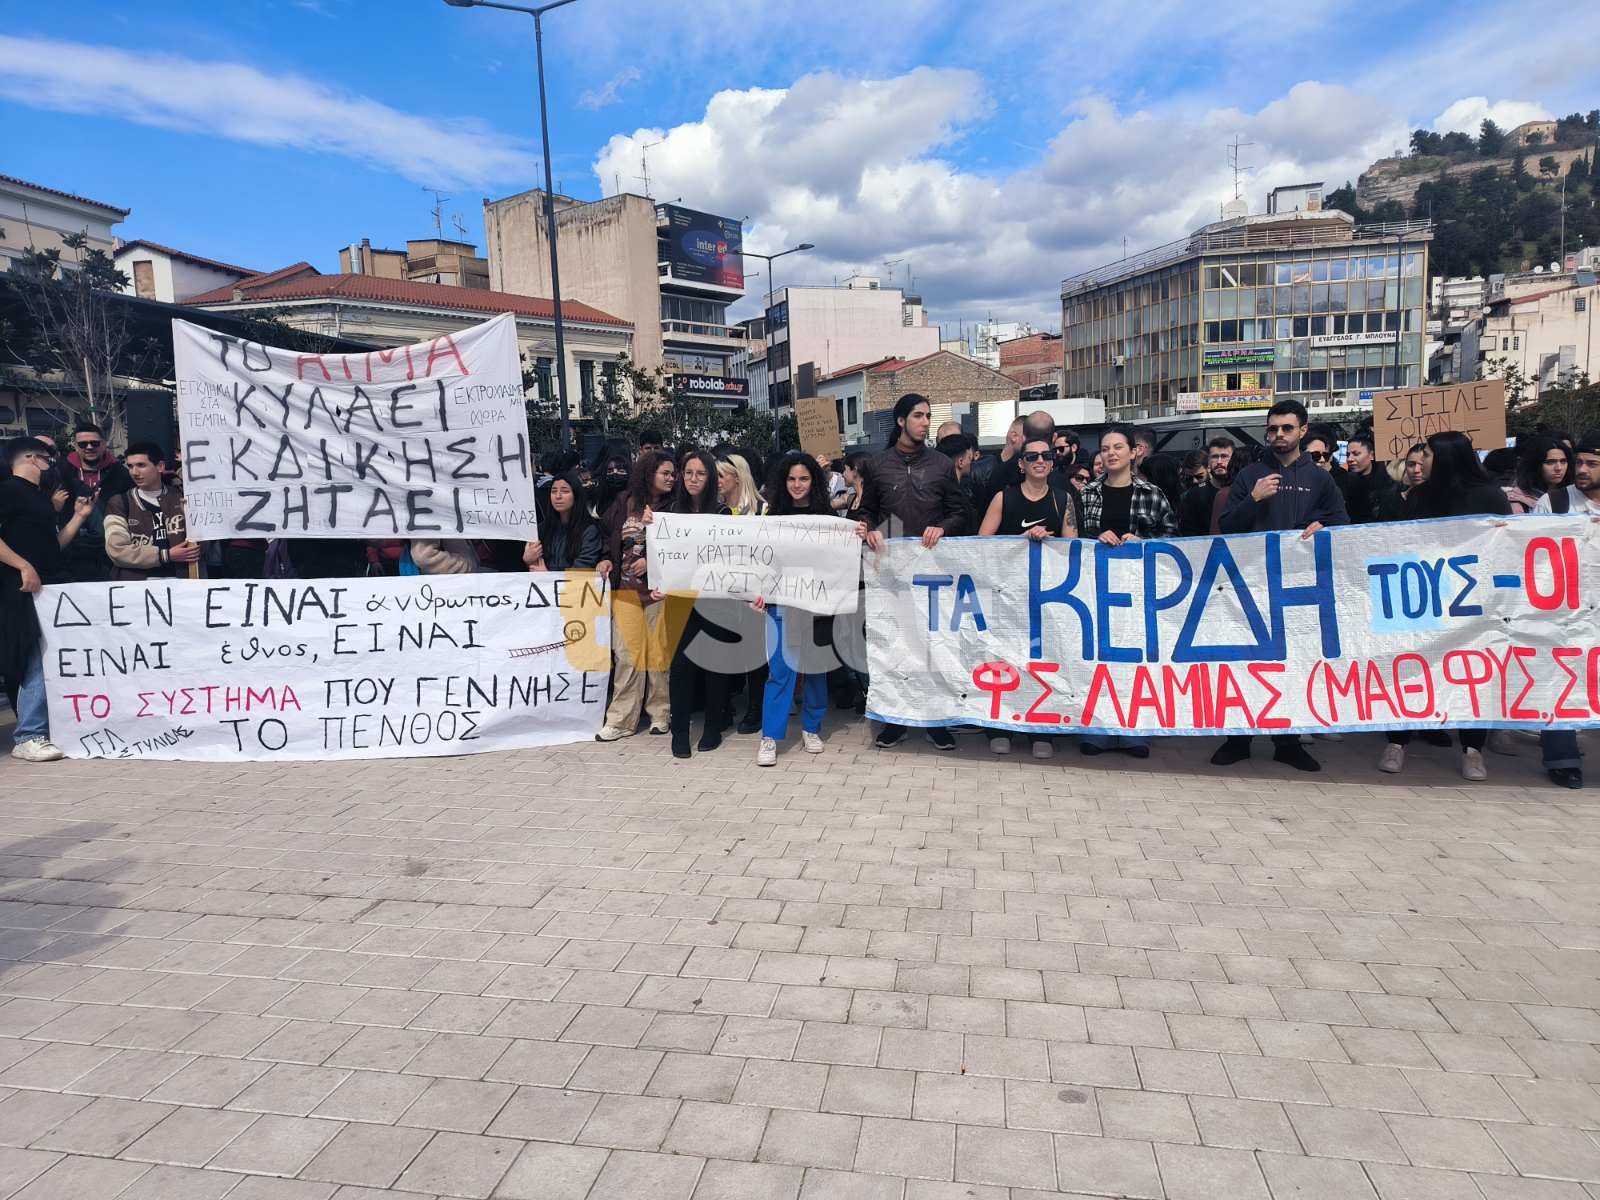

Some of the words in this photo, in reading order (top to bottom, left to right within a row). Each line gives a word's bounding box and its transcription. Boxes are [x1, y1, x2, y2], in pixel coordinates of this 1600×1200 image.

[211, 334, 272, 372] ΤΟ
[297, 336, 470, 382] ΑΙΜΑ
[1318, 334, 1353, 342] ΕΥΑΓΓΕΛΟΣ
[184, 412, 227, 428] ΤΕΜΠΗ
[234, 379, 450, 434] ΚΥΛΑΕΙ
[1386, 384, 1489, 420] ΣΤΕΙΛΕ
[187, 434, 527, 485] ΕΚΔΙΚΗΣΗ
[185, 491, 233, 508] ΤΕΜΠΗ
[235, 485, 464, 534] ΖΗΤΑΕΙ
[465, 510, 537, 525] ΣΤΥΛΙΔΑΣ
[473, 488, 515, 506] ΓΕΛ
[656, 516, 692, 540] Δεν
[658, 549, 689, 565] ήταν
[697, 545, 774, 566] ΚΡΑΤΙΚΟ
[53, 585, 173, 628] ΔΕΝ
[206, 583, 348, 628] ΕΙΝΑΙ
[525, 579, 605, 609] ΔΕΝ
[703, 571, 828, 601] ΔΥΣΤΥΧΗΜΑ
[912, 574, 988, 632] ΤΑ
[1028, 531, 1342, 663] ΚΕΡΔΗ
[58, 641, 172, 678] ΕΙΝΑΙ
[333, 620, 486, 655] ΕΙΝΑΙ
[63, 694, 112, 723] ΤΟ
[136, 684, 302, 718] ΣΥΣΤΗΜΑ
[323, 678, 396, 708] ΠΟΥ
[1080, 662, 1292, 729] ΛΑΜΙΑΣ
[219, 718, 289, 752] ΤΟ
[318, 710, 481, 749] ΠΕΝΘΟΣ
